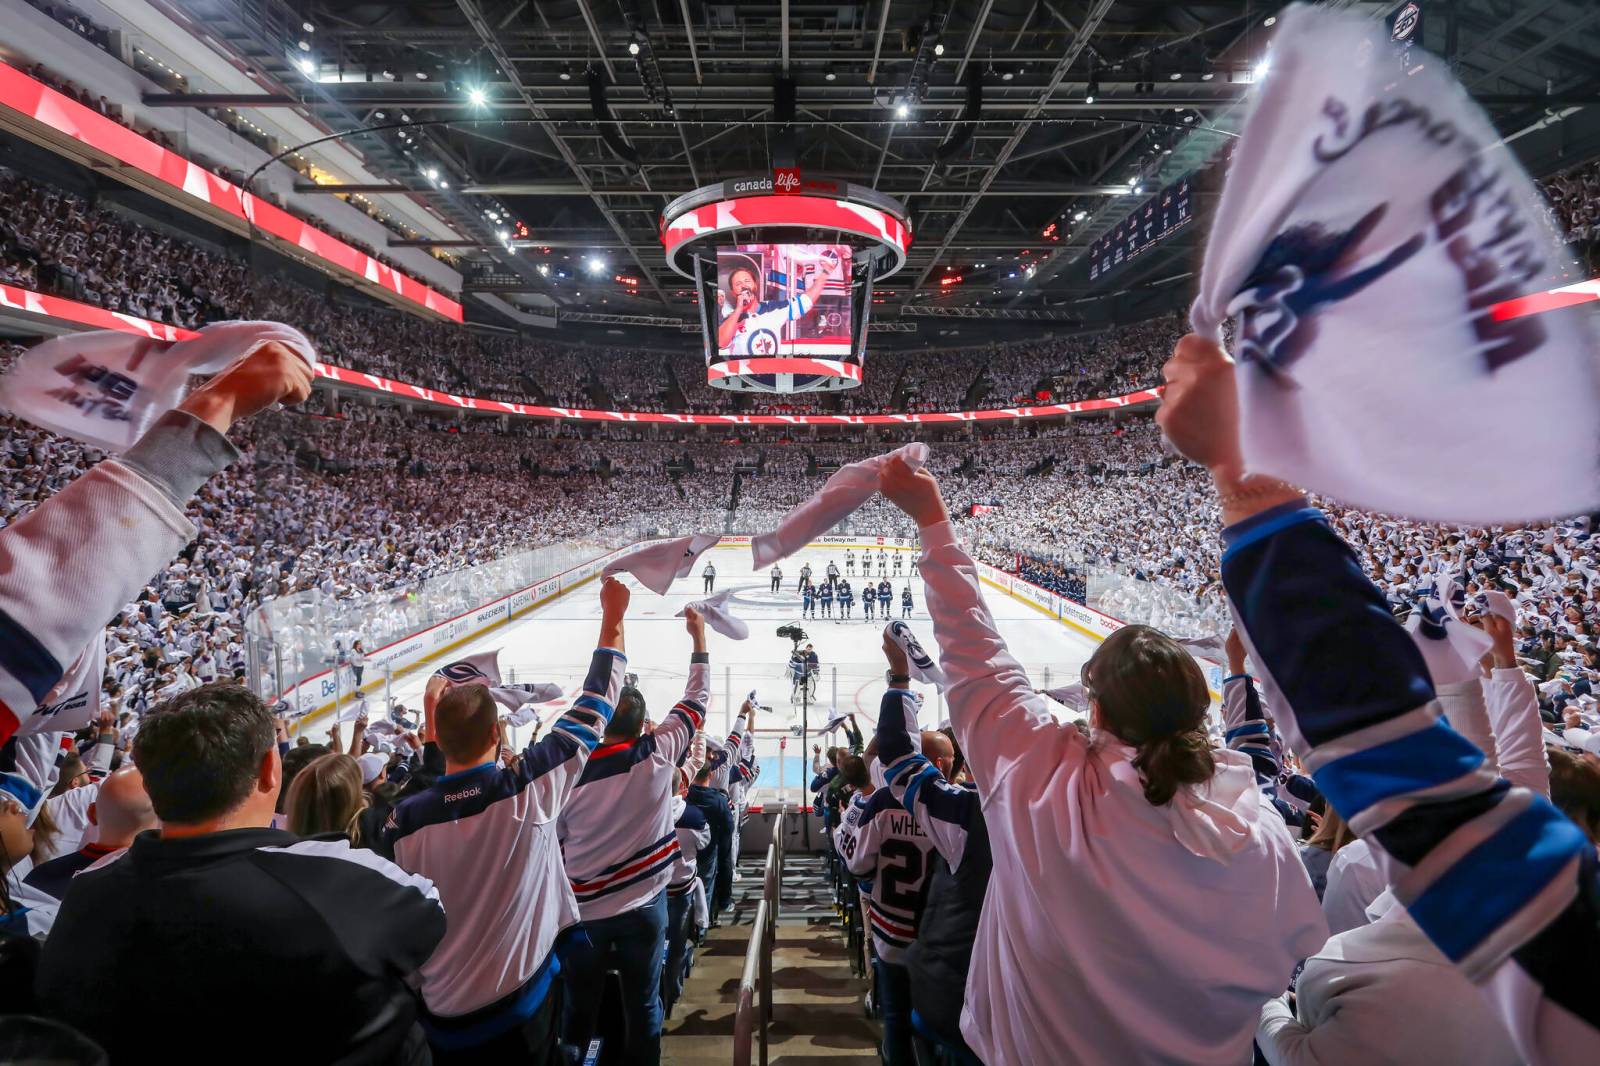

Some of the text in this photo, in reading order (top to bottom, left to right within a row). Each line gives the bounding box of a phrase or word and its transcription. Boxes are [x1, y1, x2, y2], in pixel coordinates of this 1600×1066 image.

[734, 177, 772, 192] canada
[774, 172, 801, 191] life
[444, 786, 481, 804] Reebok
[890, 814, 928, 838] WHE
